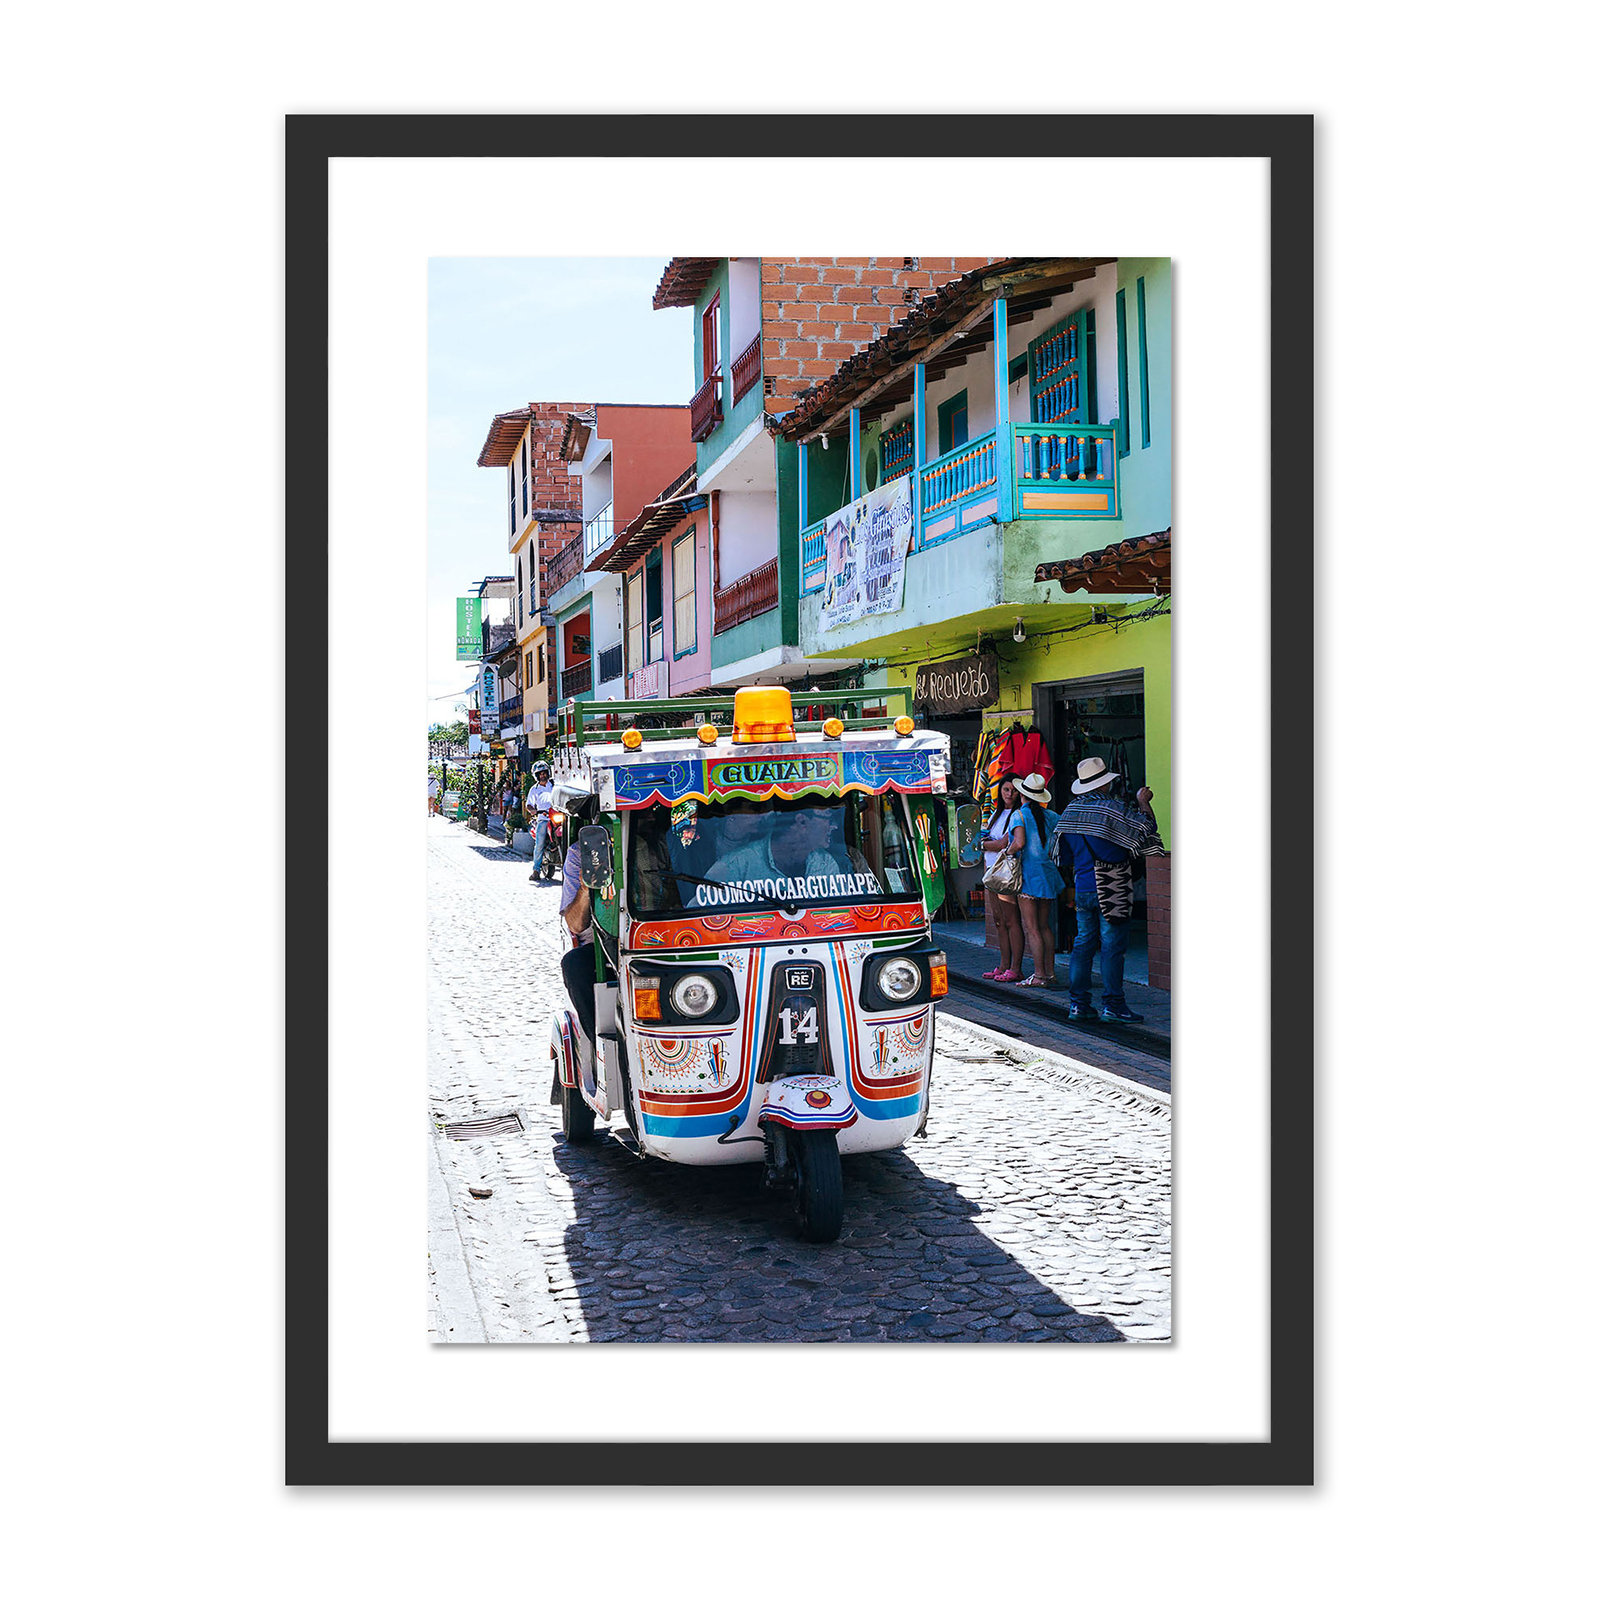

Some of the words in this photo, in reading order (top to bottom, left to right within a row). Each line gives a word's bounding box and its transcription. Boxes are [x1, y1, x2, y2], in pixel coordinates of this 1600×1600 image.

[465, 598, 474, 637] HOSTEL
[484, 674, 495, 707] HOSTEL
[720, 760, 831, 784] GUATAPE
[791, 974, 810, 986] RE
[778, 1006, 819, 1045] 14
